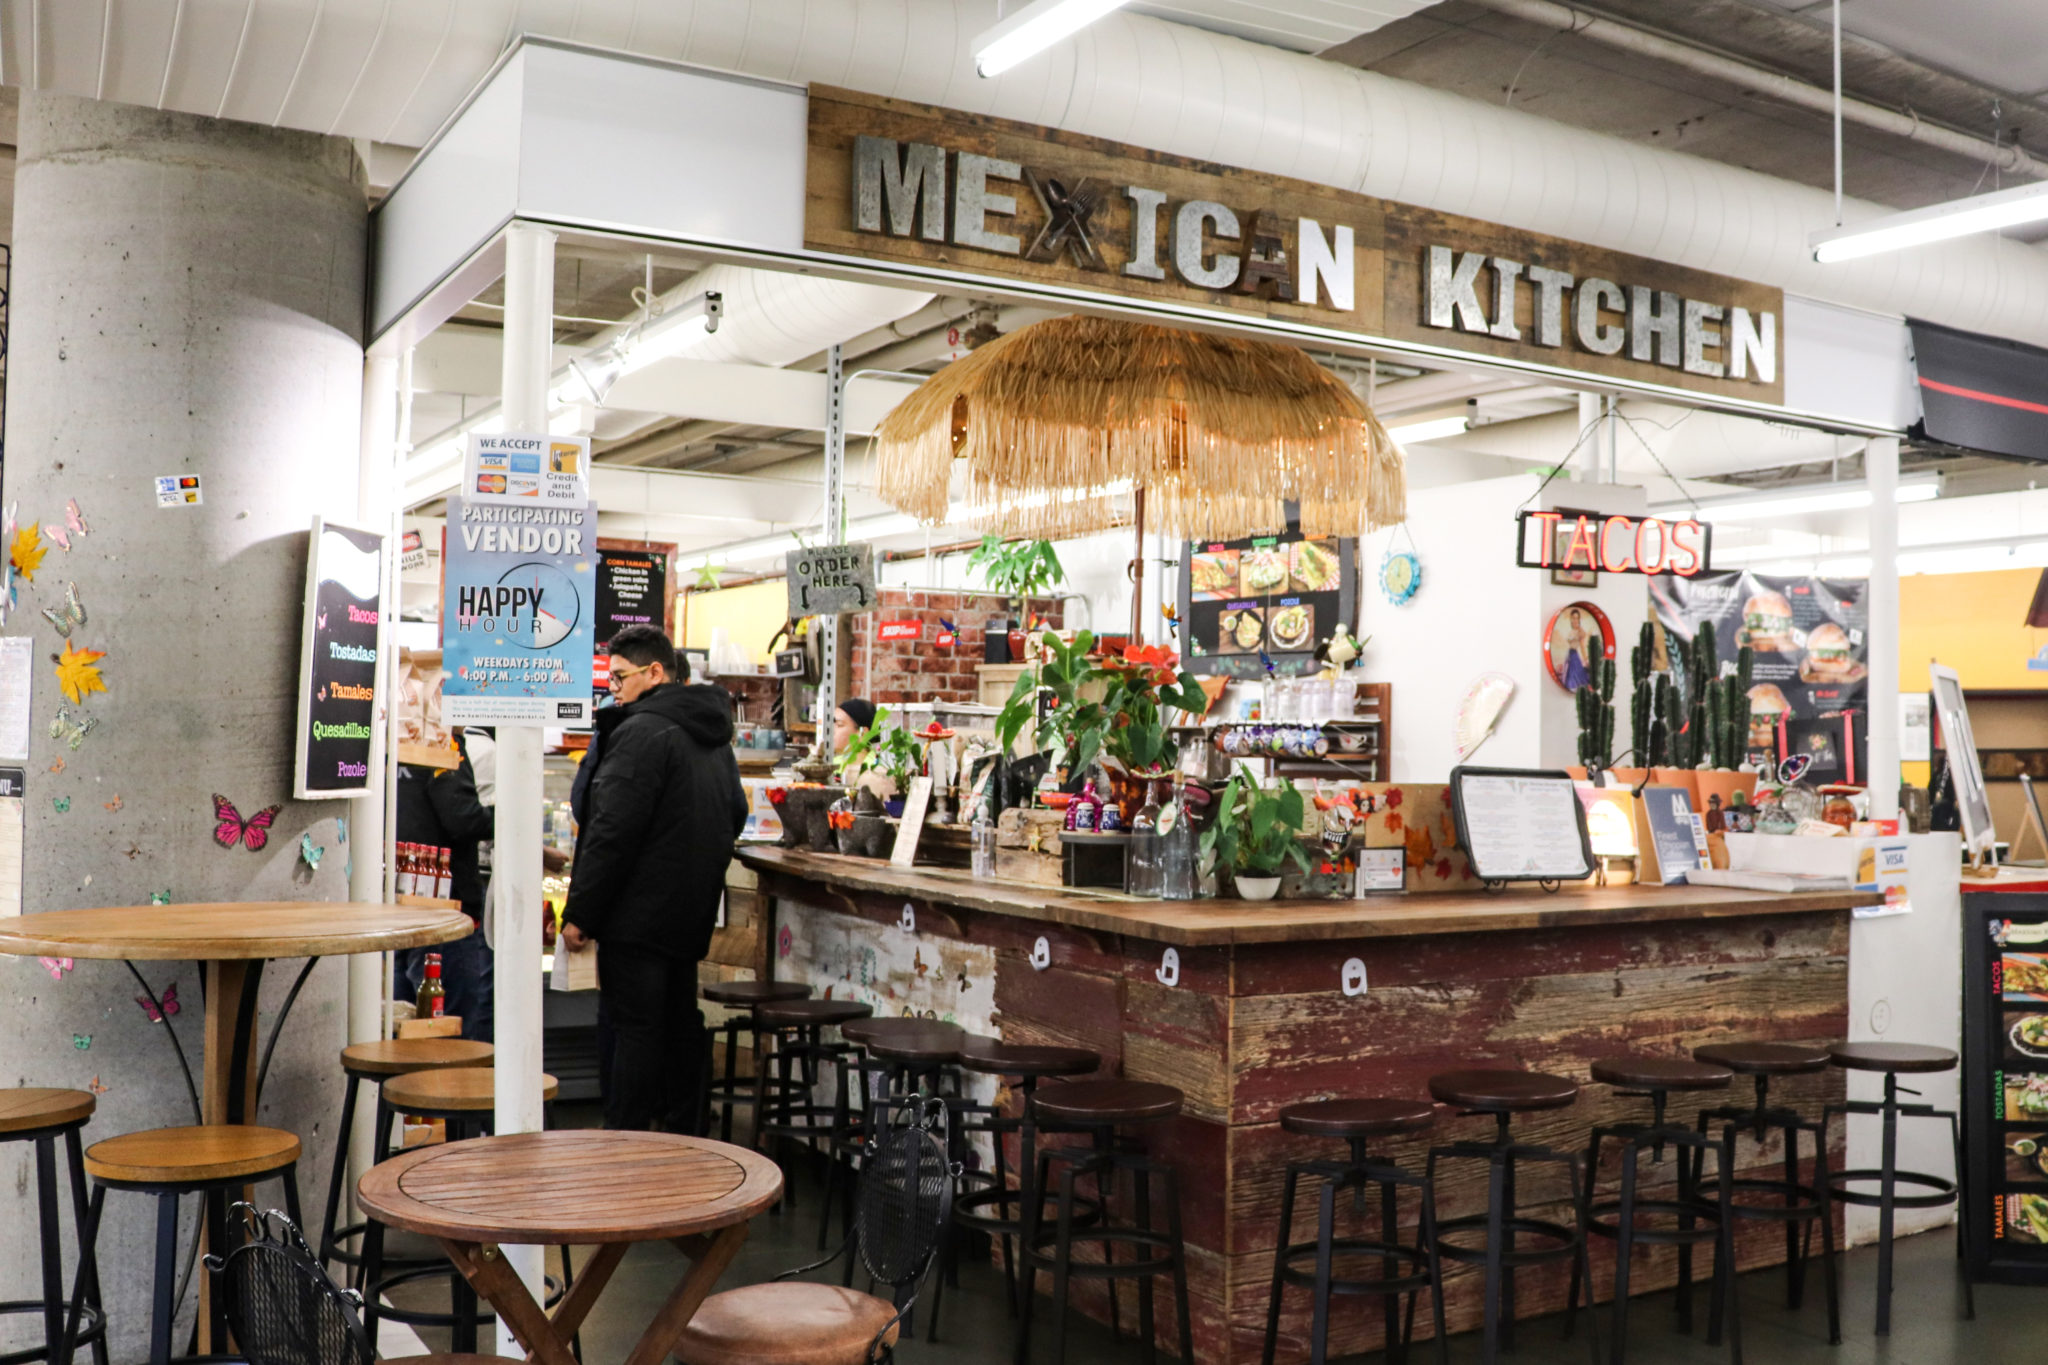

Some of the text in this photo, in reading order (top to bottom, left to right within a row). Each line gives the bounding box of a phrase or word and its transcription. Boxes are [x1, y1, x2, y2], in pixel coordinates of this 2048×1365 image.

[853, 133, 1775, 383] MEXICAN KITCHEN
[480, 439, 542, 450] WE ACCEPT
[546, 473, 578, 482] Credit
[547, 491, 575, 499] Debit
[462, 506, 584, 525] PARTICIPATING
[461, 525, 582, 555] VENDOR
[1532, 512, 1699, 576] TACOS
[799, 556, 860, 574] ORDER
[812, 574, 850, 588] HERE
[459, 586, 544, 618] HAPPY
[348, 605, 378, 624] Tacos
[459, 618, 542, 634] HOUR
[330, 642, 376, 662] Tostadas
[473, 656, 564, 669] WEEKDAYS FROM
[462, 670, 488, 681] 4:00
[490, 671, 513, 682] P.M.
[523, 672, 549, 683] 6:00
[550, 673, 575, 684] P.M.
[330, 681, 374, 700] Tamales
[313, 720, 371, 741] Quesadillas
[337, 761, 367, 777] Pozole
[1885, 854, 1905, 866] VISA
[1992, 960, 2001, 995] TACOS
[1994, 1069, 2003, 1121] TOSTADAS
[1994, 1193, 2004, 1239] TAMALES
